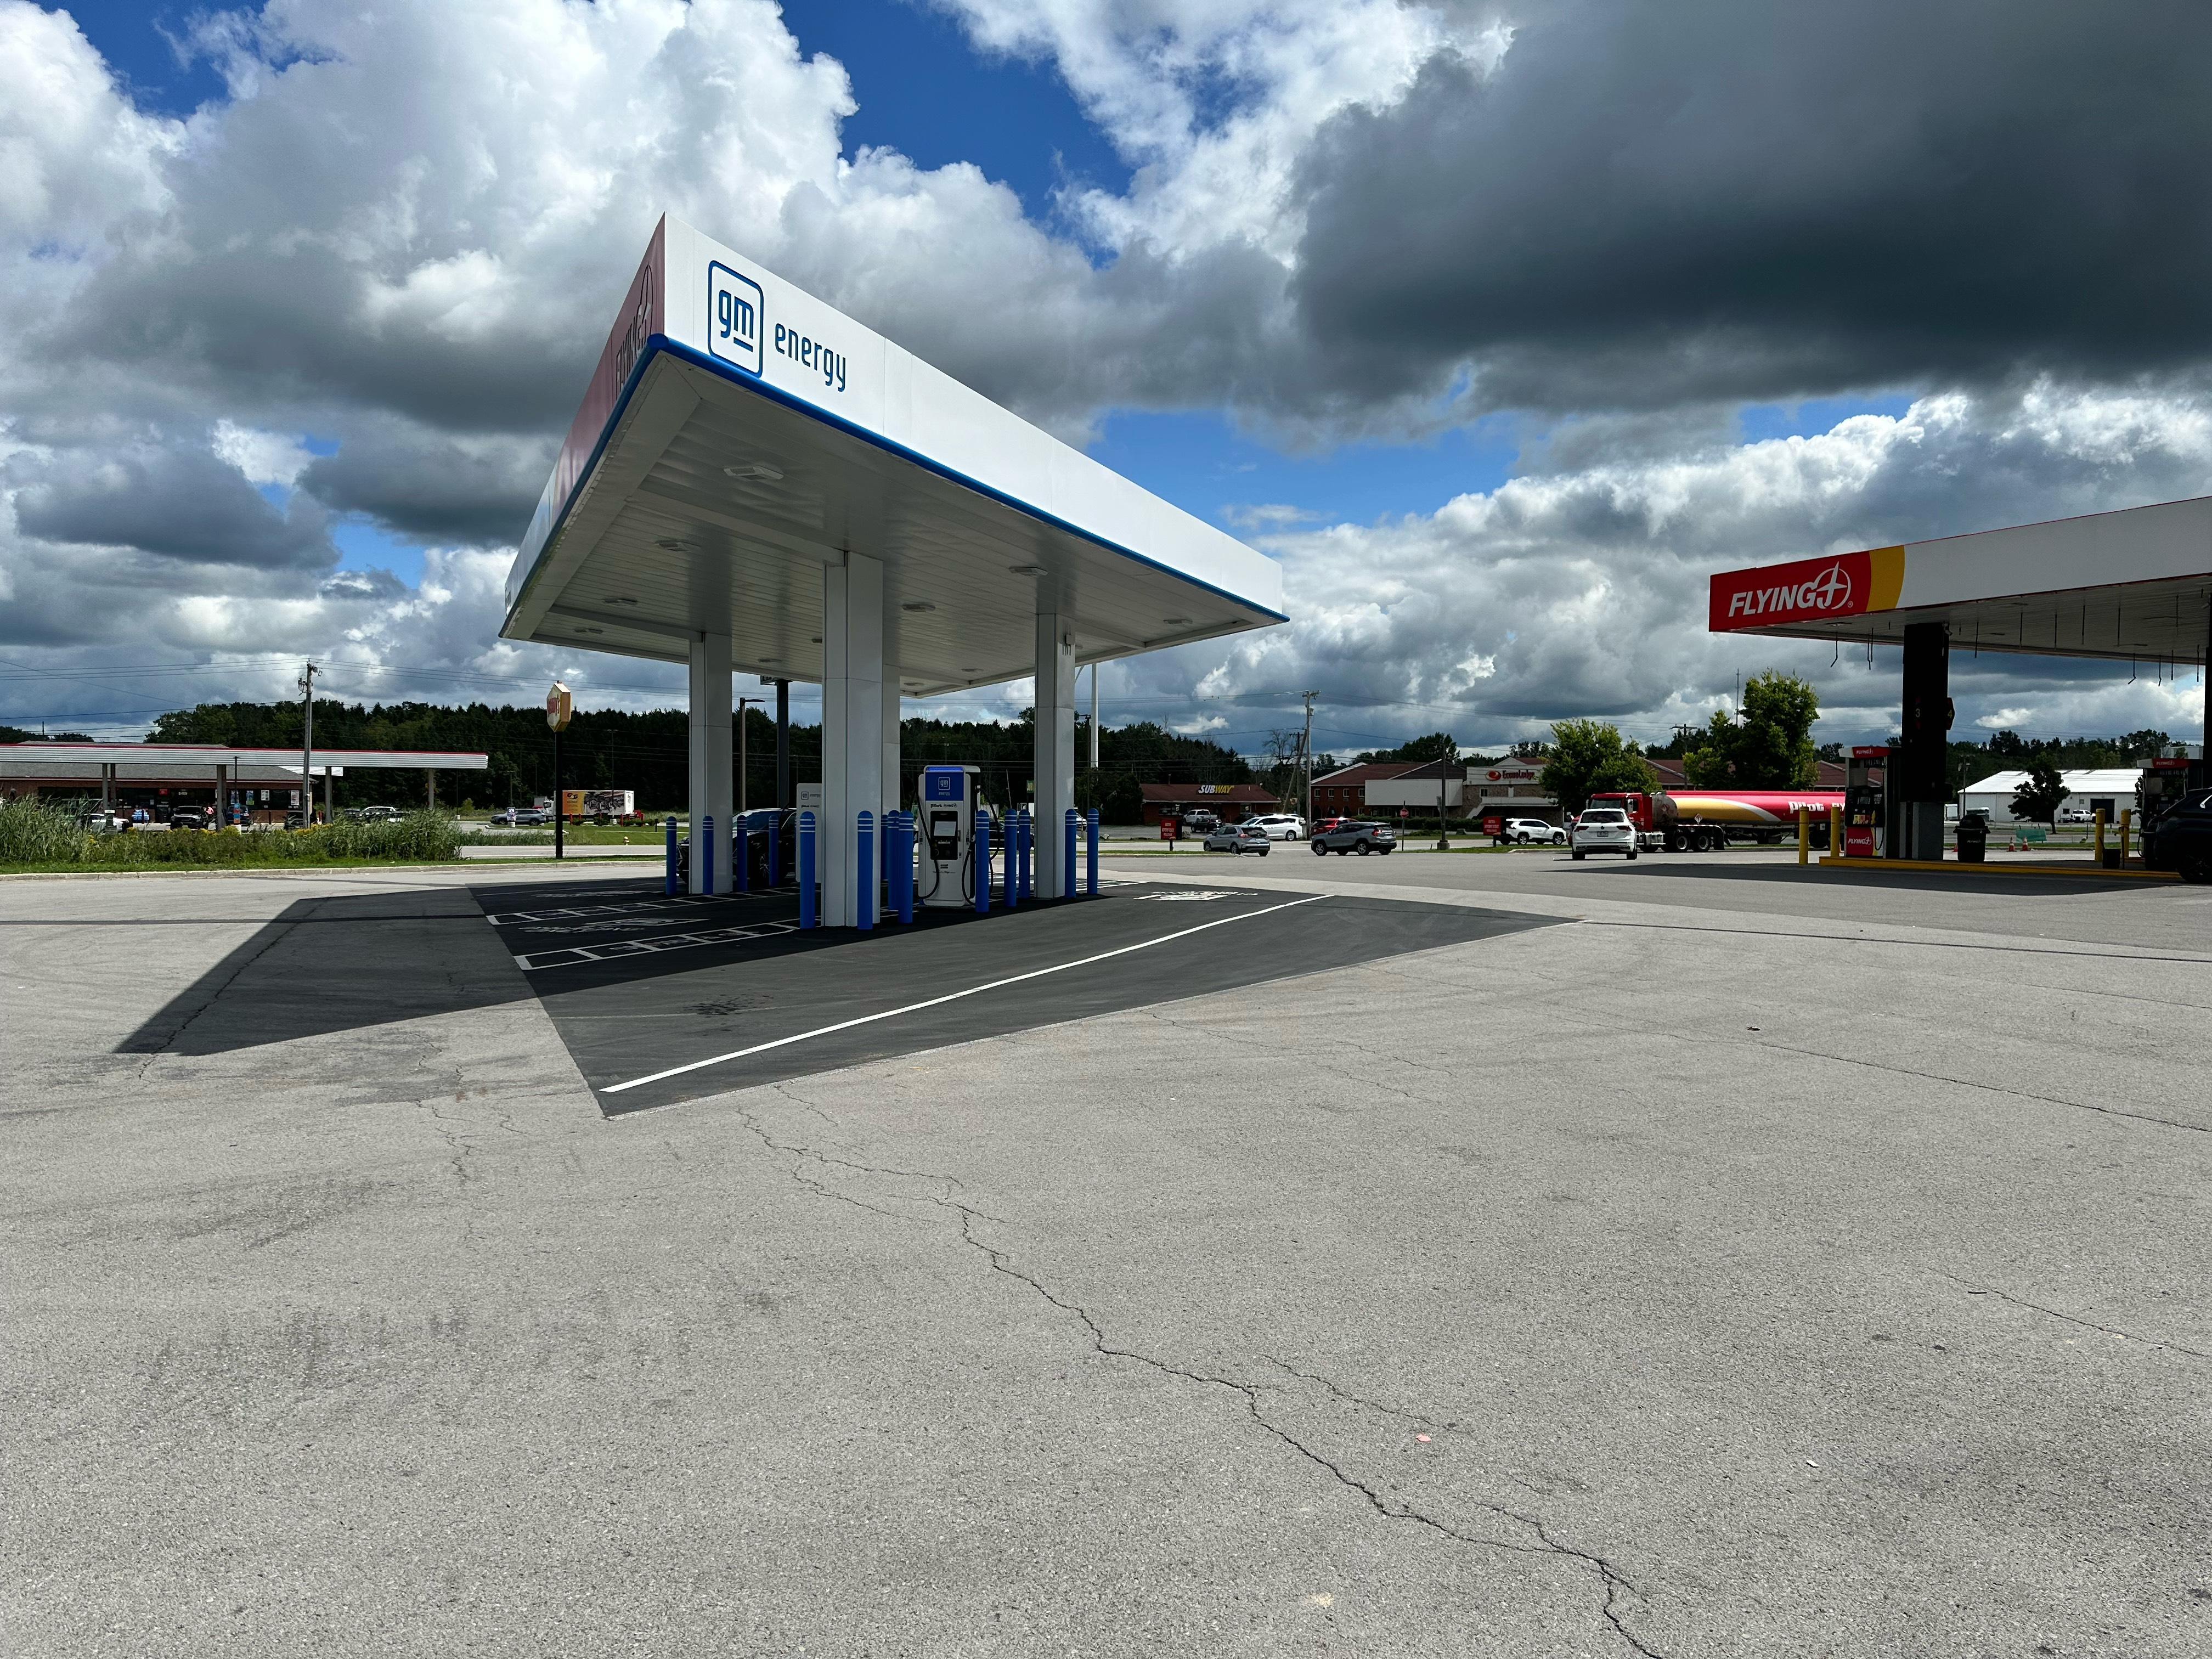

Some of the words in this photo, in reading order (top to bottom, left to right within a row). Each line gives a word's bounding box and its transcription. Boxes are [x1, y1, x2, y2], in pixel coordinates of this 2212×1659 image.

[718, 289, 754, 340] gm
[775, 323, 846, 392] energy
[1915, 708, 1920, 718] 3
[1947, 709, 1953, 719] 4
[1198, 785, 1234, 793] SUBWAY
